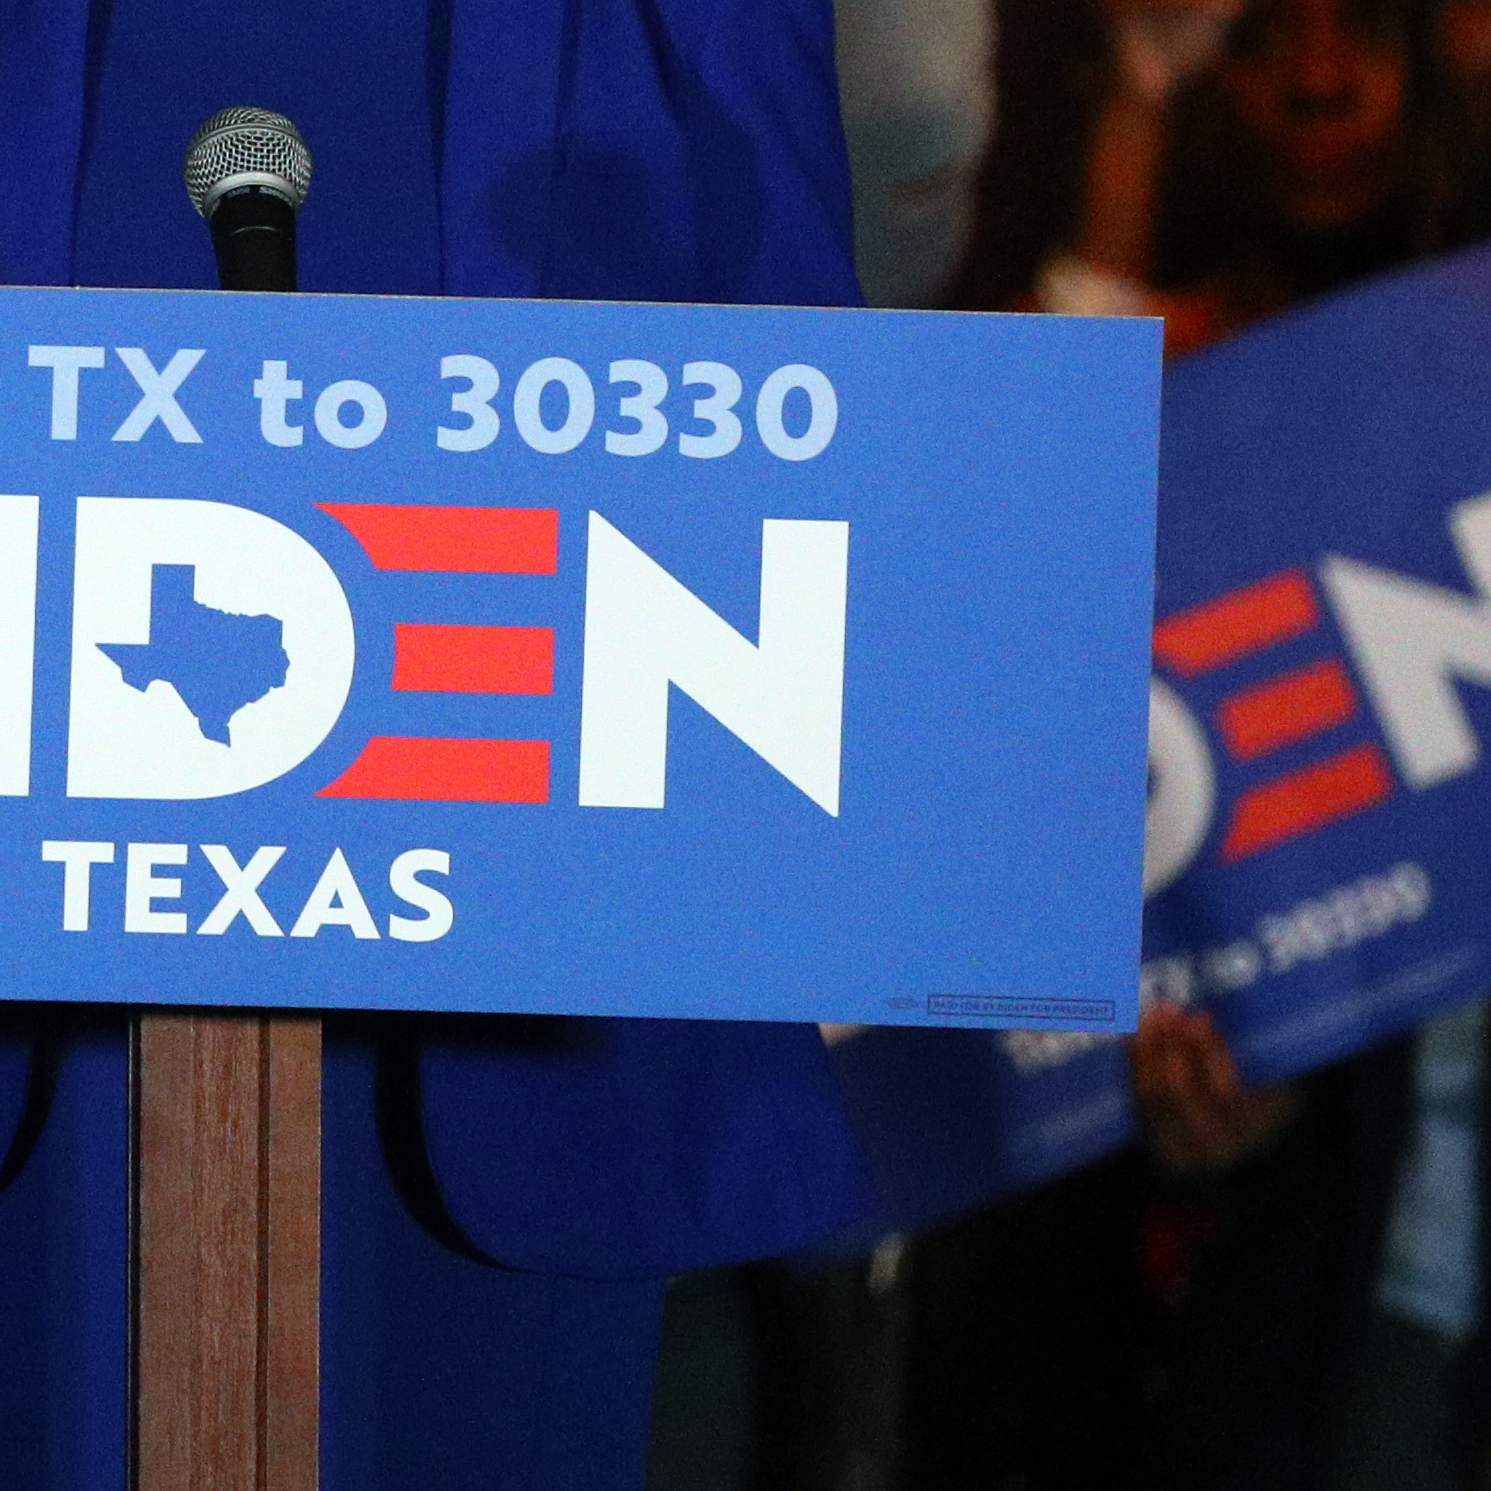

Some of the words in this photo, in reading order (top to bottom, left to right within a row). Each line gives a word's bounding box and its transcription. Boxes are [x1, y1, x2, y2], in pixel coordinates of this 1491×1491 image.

[28, 345, 206, 443] TX
[254, 360, 388, 449] to
[437, 354, 839, 461] 30330
[42, 840, 455, 943] TEXAS
